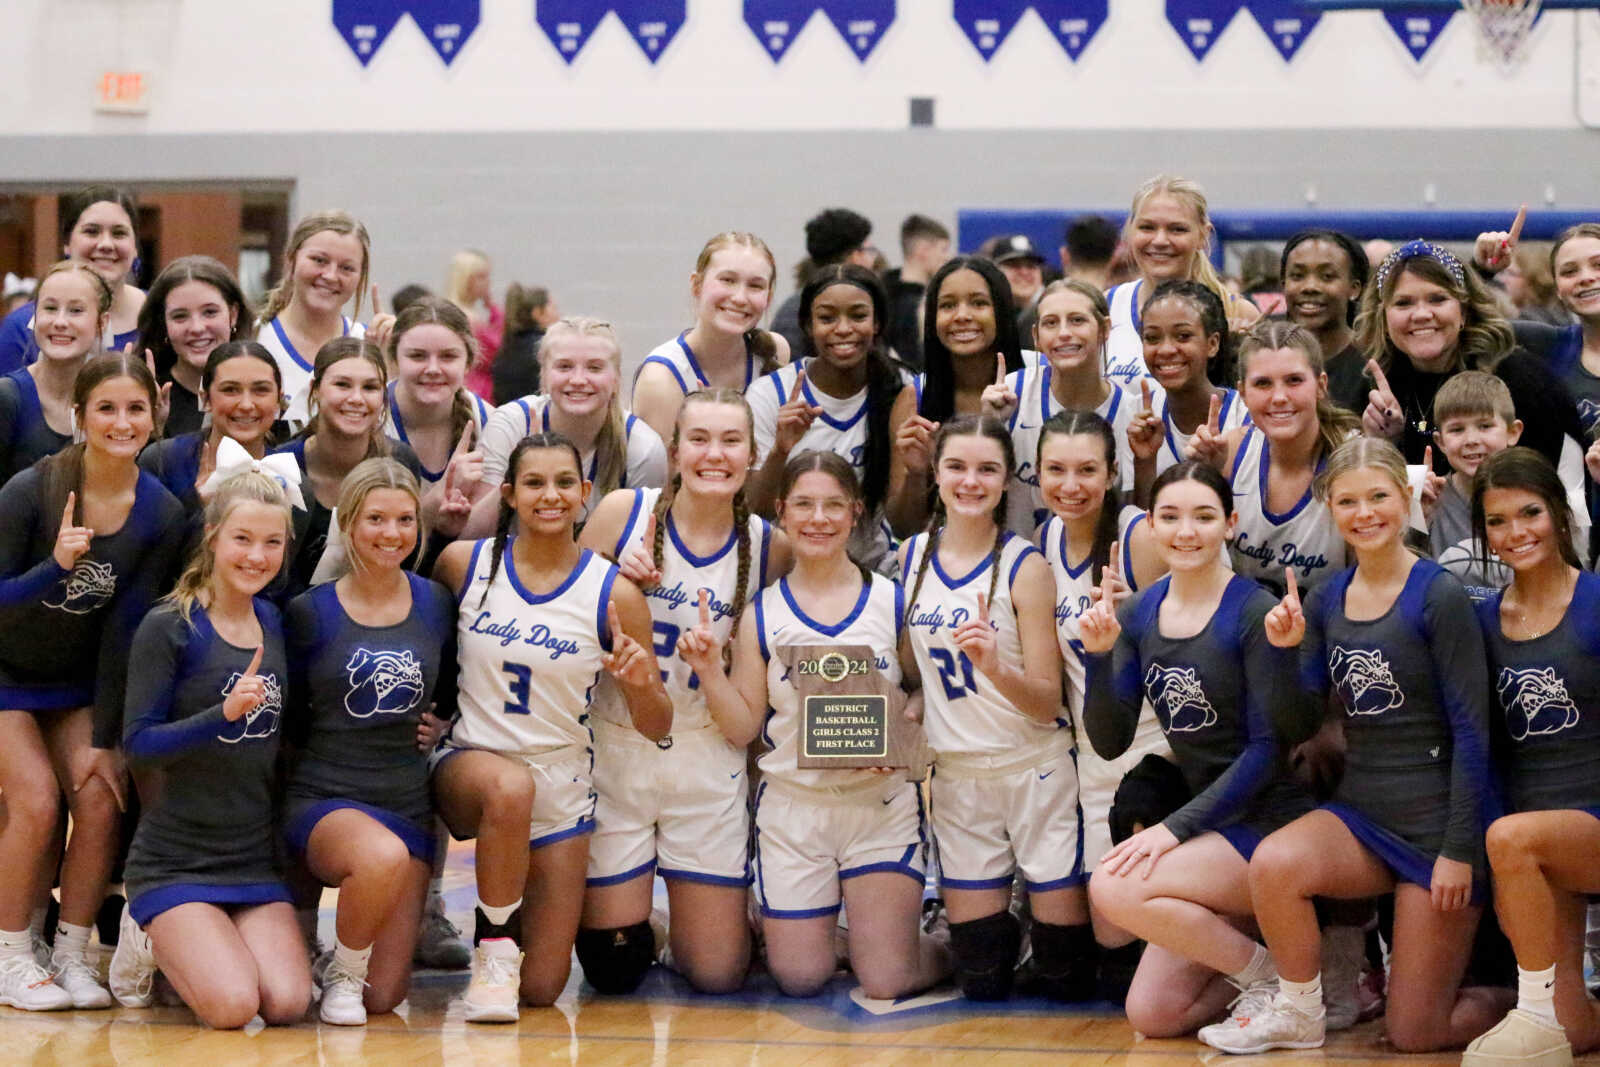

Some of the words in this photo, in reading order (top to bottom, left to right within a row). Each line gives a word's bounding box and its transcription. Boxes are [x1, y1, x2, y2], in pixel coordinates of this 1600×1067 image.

[1235, 532, 1275, 568] Lady
[1278, 543, 1328, 577] Dogs
[909, 604, 945, 635] Lady
[469, 611, 521, 647] Lady
[524, 624, 580, 660] Dogs
[799, 660, 818, 674] 20
[849, 660, 868, 674] 24
[929, 647, 978, 702] 21
[502, 660, 532, 715] 3
[824, 705, 868, 713] DISTRICT
[816, 717, 877, 725] BASKETBALL
[812, 729, 842, 737] GIRLS
[843, 729, 873, 737] CLASS
[874, 729, 880, 737] 2
[816, 741, 843, 749] FIRST
[844, 741, 876, 749] PLACE
